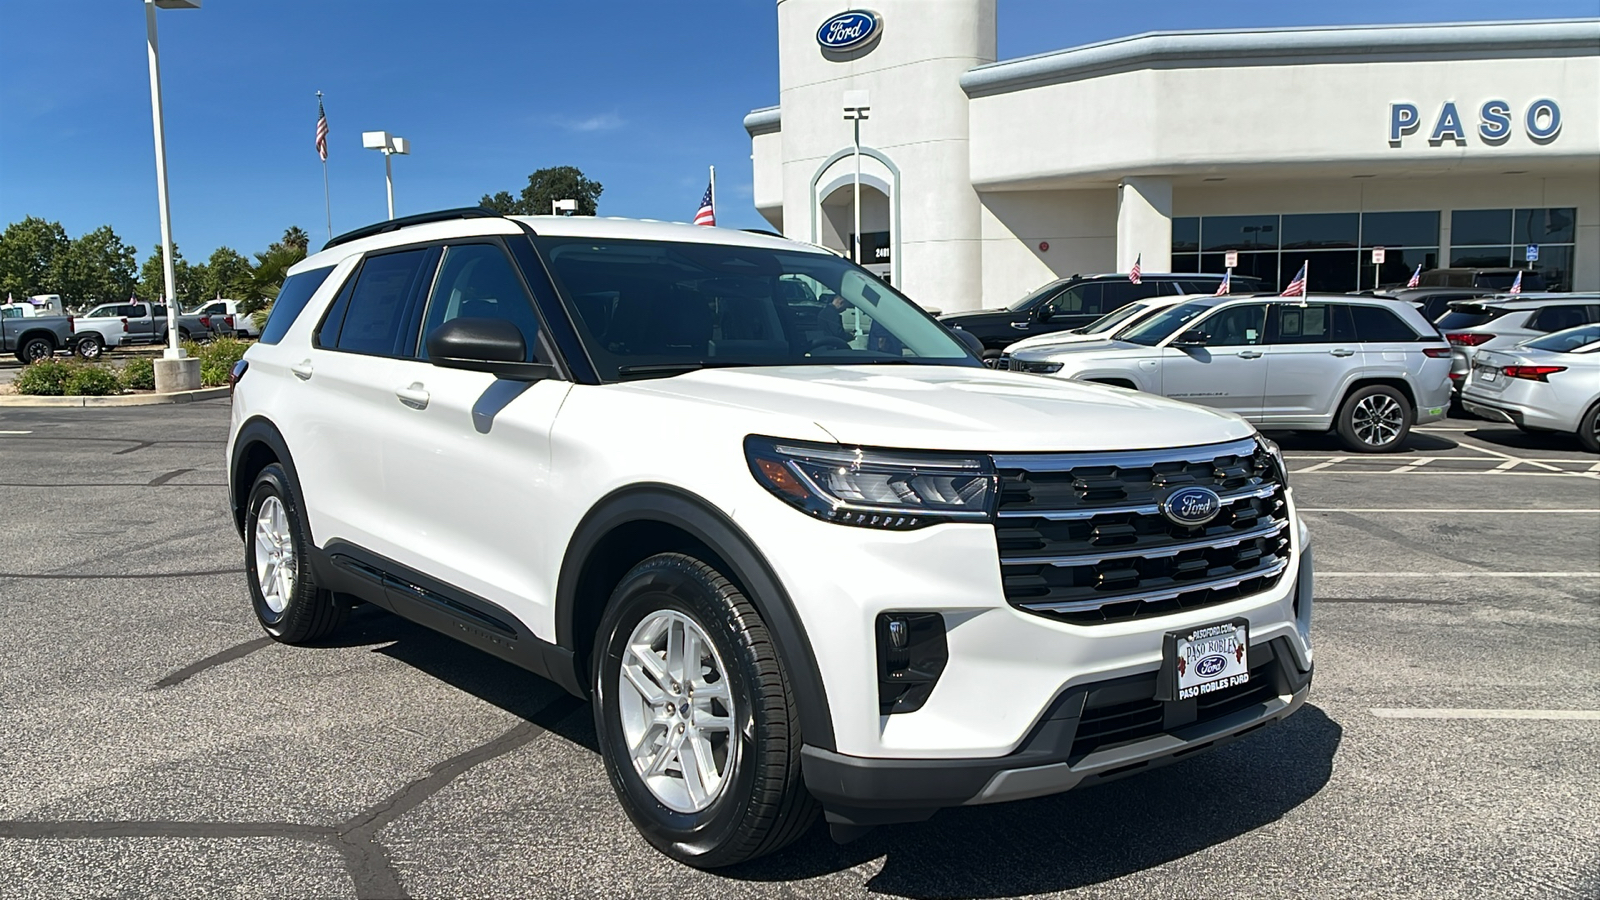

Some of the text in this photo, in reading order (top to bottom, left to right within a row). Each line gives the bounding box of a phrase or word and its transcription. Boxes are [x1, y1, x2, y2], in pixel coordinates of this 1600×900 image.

[826, 17, 864, 43] Ford
[1389, 98, 1563, 146] PASO
[1181, 495, 1211, 516] Ford
[1187, 637, 1236, 665] PASO ROBLES
[1201, 659, 1221, 674] Ford
[1180, 674, 1248, 700] PASO ROBLES FORD
